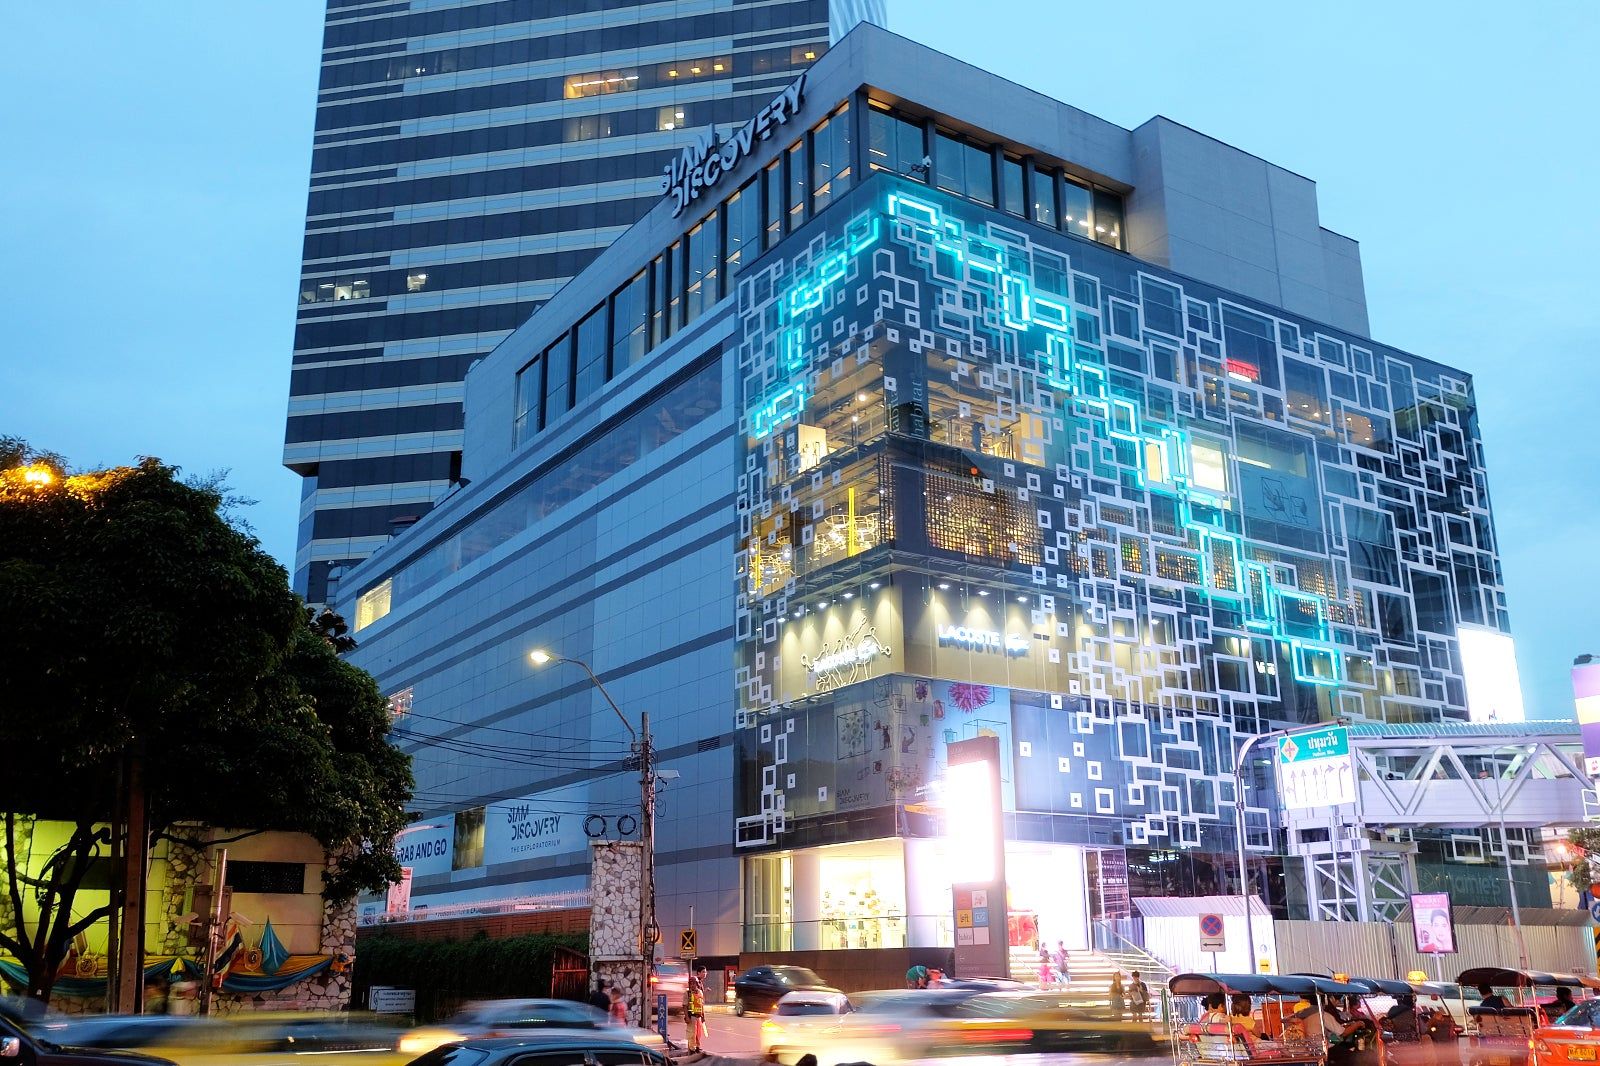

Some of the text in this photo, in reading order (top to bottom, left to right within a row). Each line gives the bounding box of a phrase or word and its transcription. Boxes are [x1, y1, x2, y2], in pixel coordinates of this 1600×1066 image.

[661, 123, 716, 195] SIAM
[671, 74, 807, 219] DISCOVERY
[938, 623, 1000, 647] LACOSTE
[507, 804, 530, 824] SIAM
[511, 815, 561, 841] DISCOVERY
[415, 841, 433, 860] AND
[434, 838, 447, 856] GO
